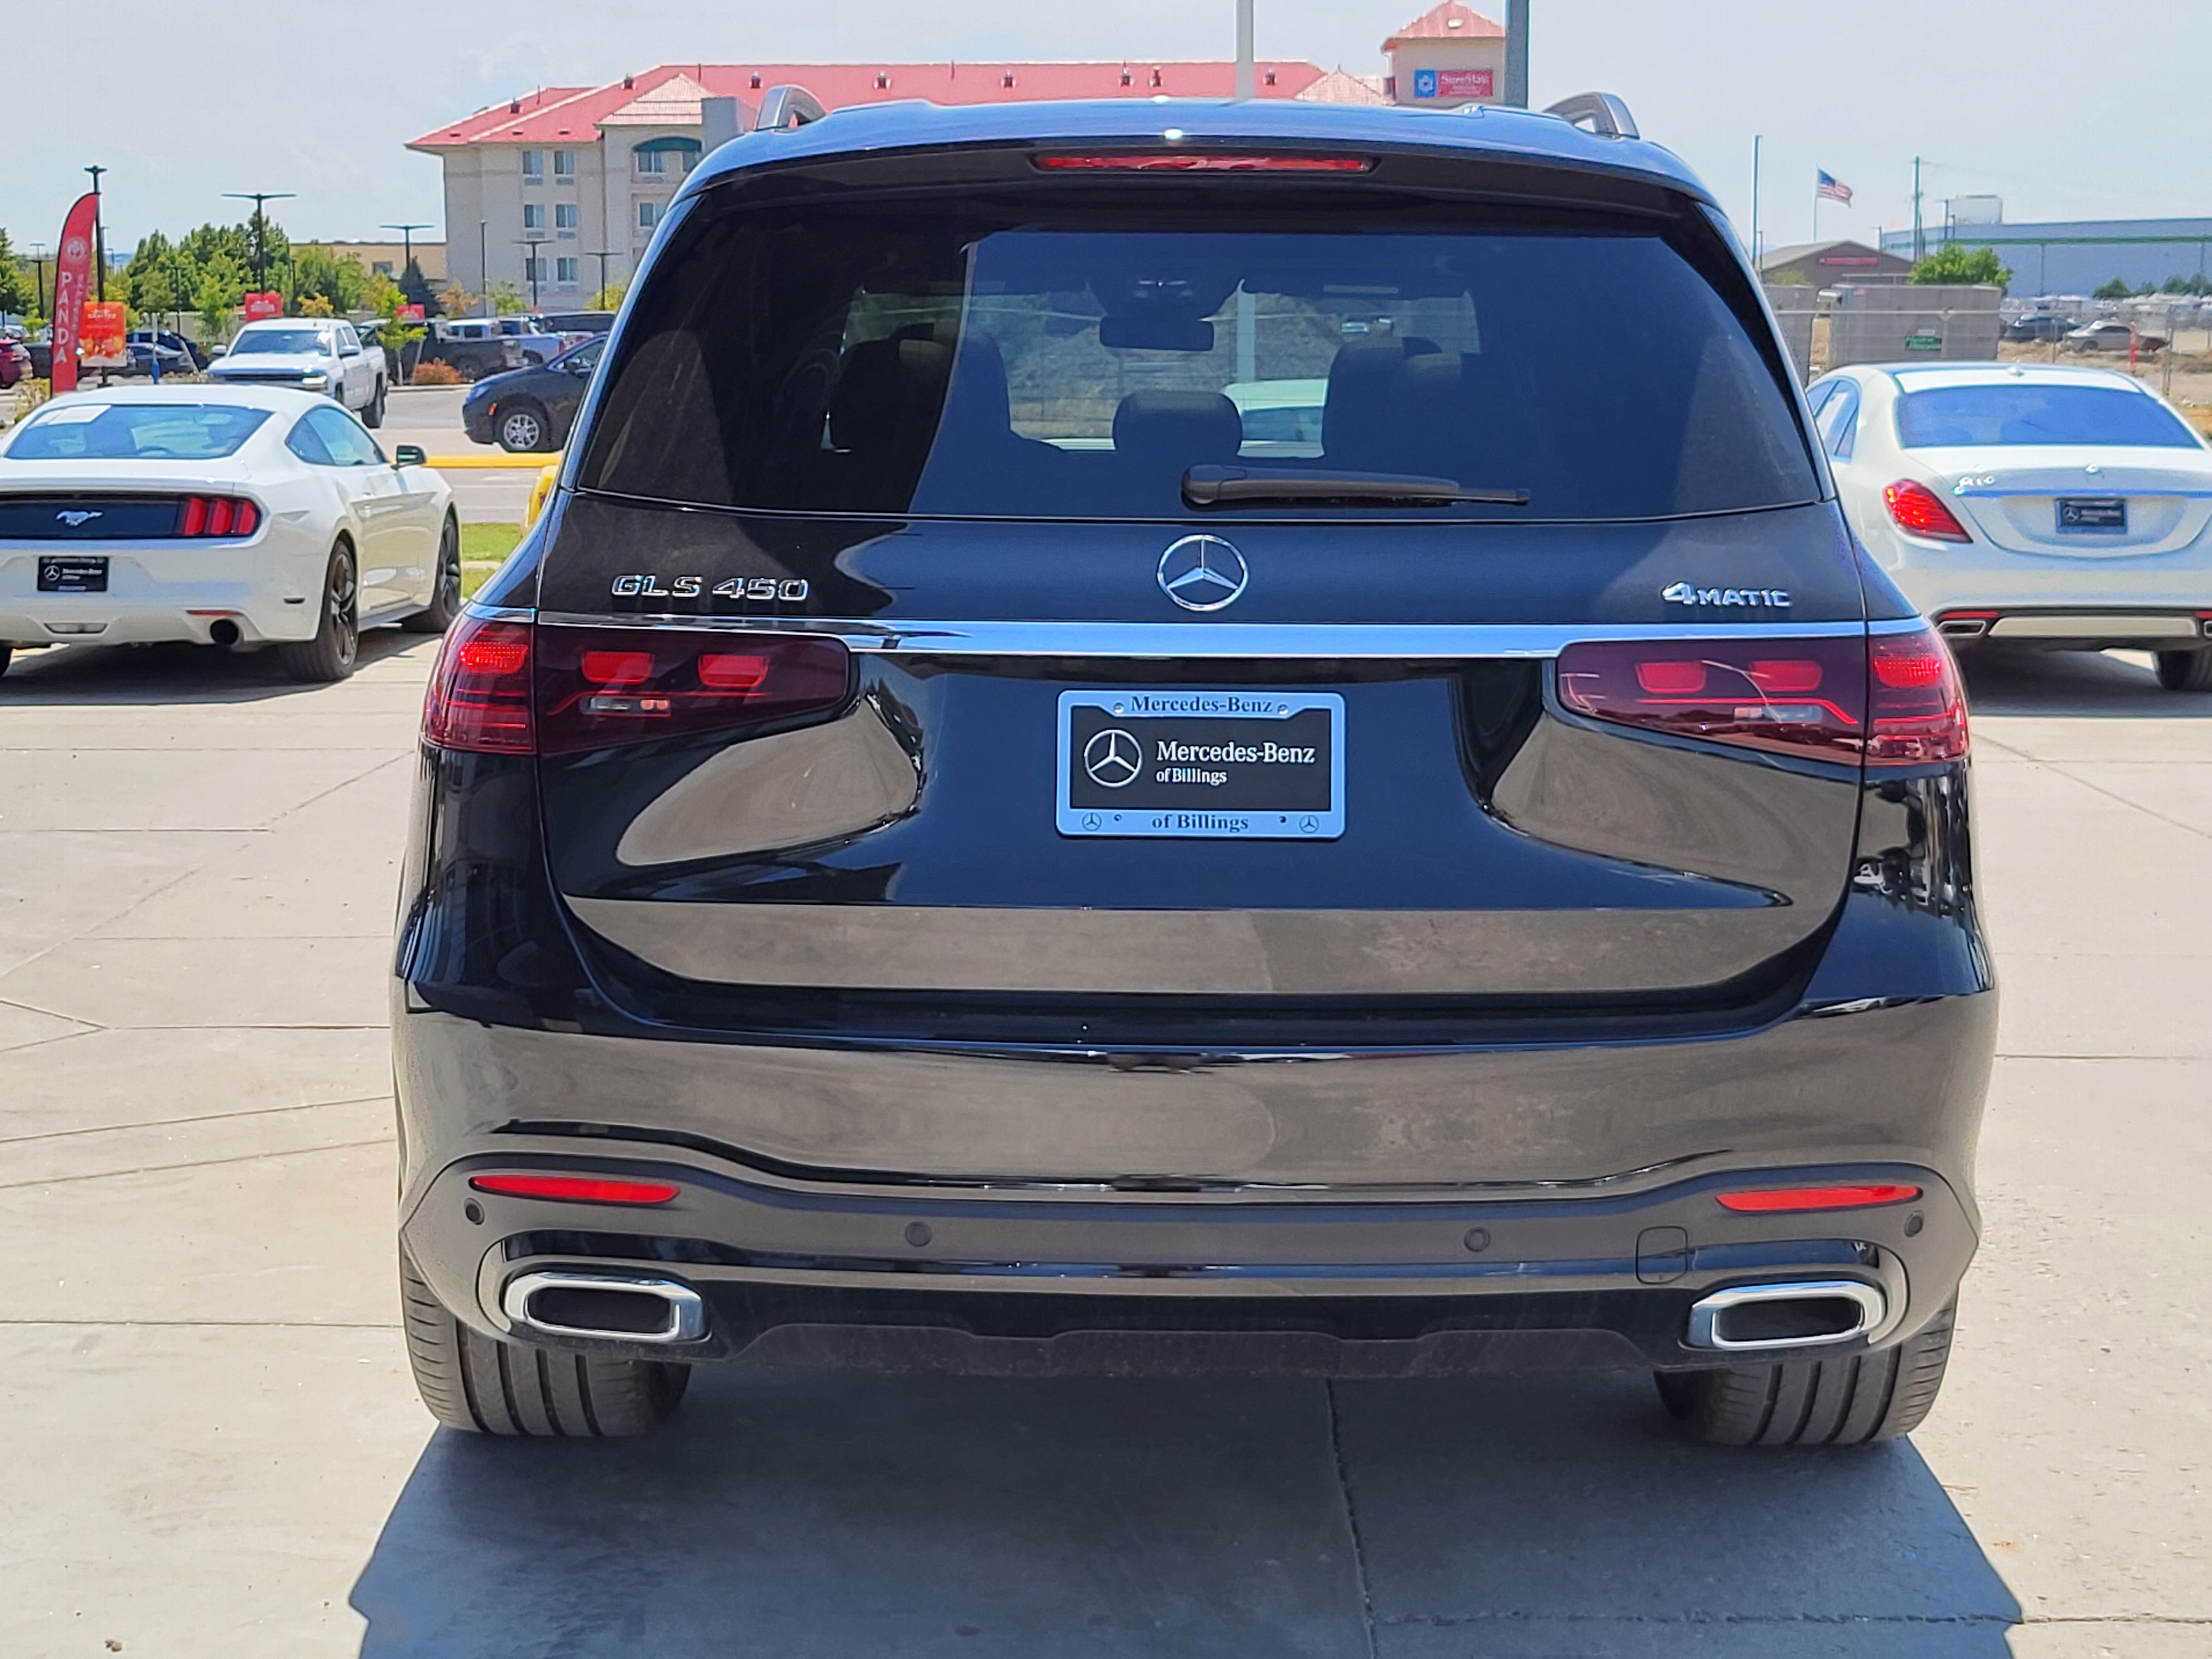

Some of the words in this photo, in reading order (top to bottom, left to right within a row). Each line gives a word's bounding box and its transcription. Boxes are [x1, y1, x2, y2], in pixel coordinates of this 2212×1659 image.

[54, 271, 73, 363] PANDA
[611, 574, 702, 597] GLS
[712, 577, 809, 601] 450
[1661, 582, 1792, 607] 4MATIC
[1131, 695, 1272, 713] Mercedes-Benz
[1156, 740, 1316, 763] Mercedes-Benz
[1156, 768, 1171, 782] of
[1172, 768, 1227, 786] Billings
[1152, 814, 1172, 828] of
[1177, 814, 1248, 833] Billings
